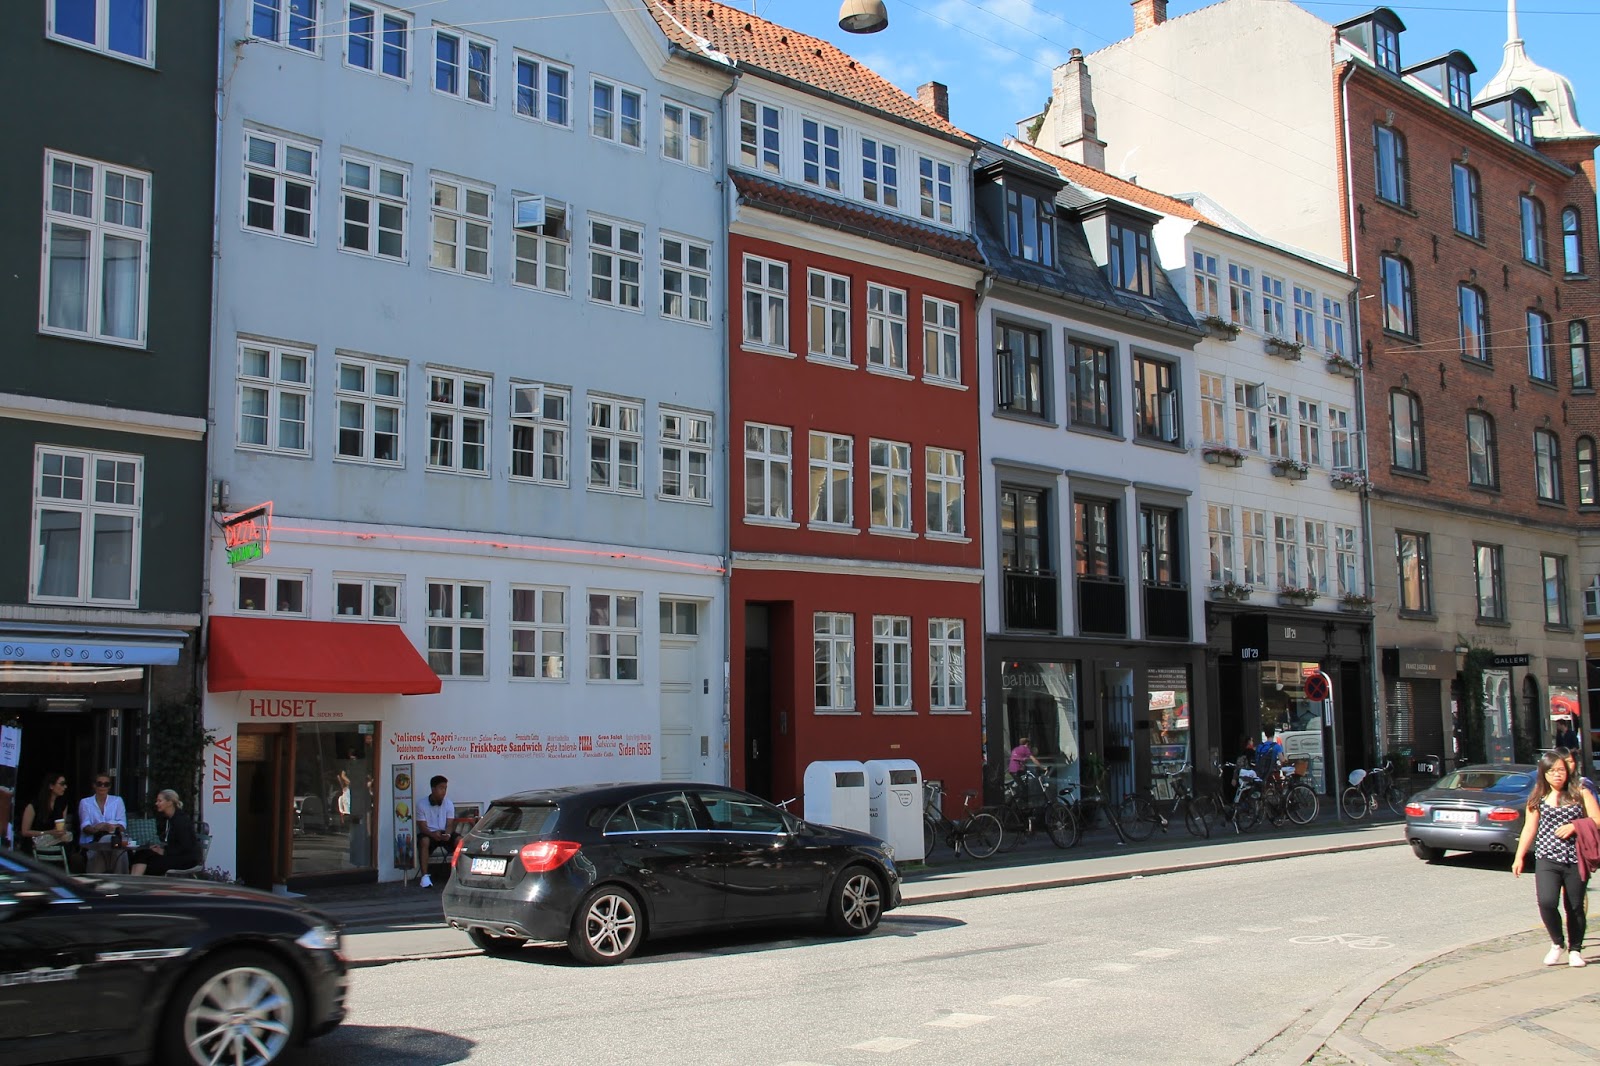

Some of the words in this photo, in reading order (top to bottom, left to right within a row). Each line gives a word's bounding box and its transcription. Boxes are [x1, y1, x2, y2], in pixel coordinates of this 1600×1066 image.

[1494, 657, 1528, 665] GALLERI
[249, 698, 317, 718] HUSET
[390, 732, 426, 745] Italiensk
[428, 731, 454, 745] Bageri
[470, 742, 508, 755] Friskbagte
[509, 742, 543, 753] Sandwich
[578, 735, 593, 752] PIZZA
[618, 743, 636, 756] Siden
[212, 735, 232, 804] PIZZA
